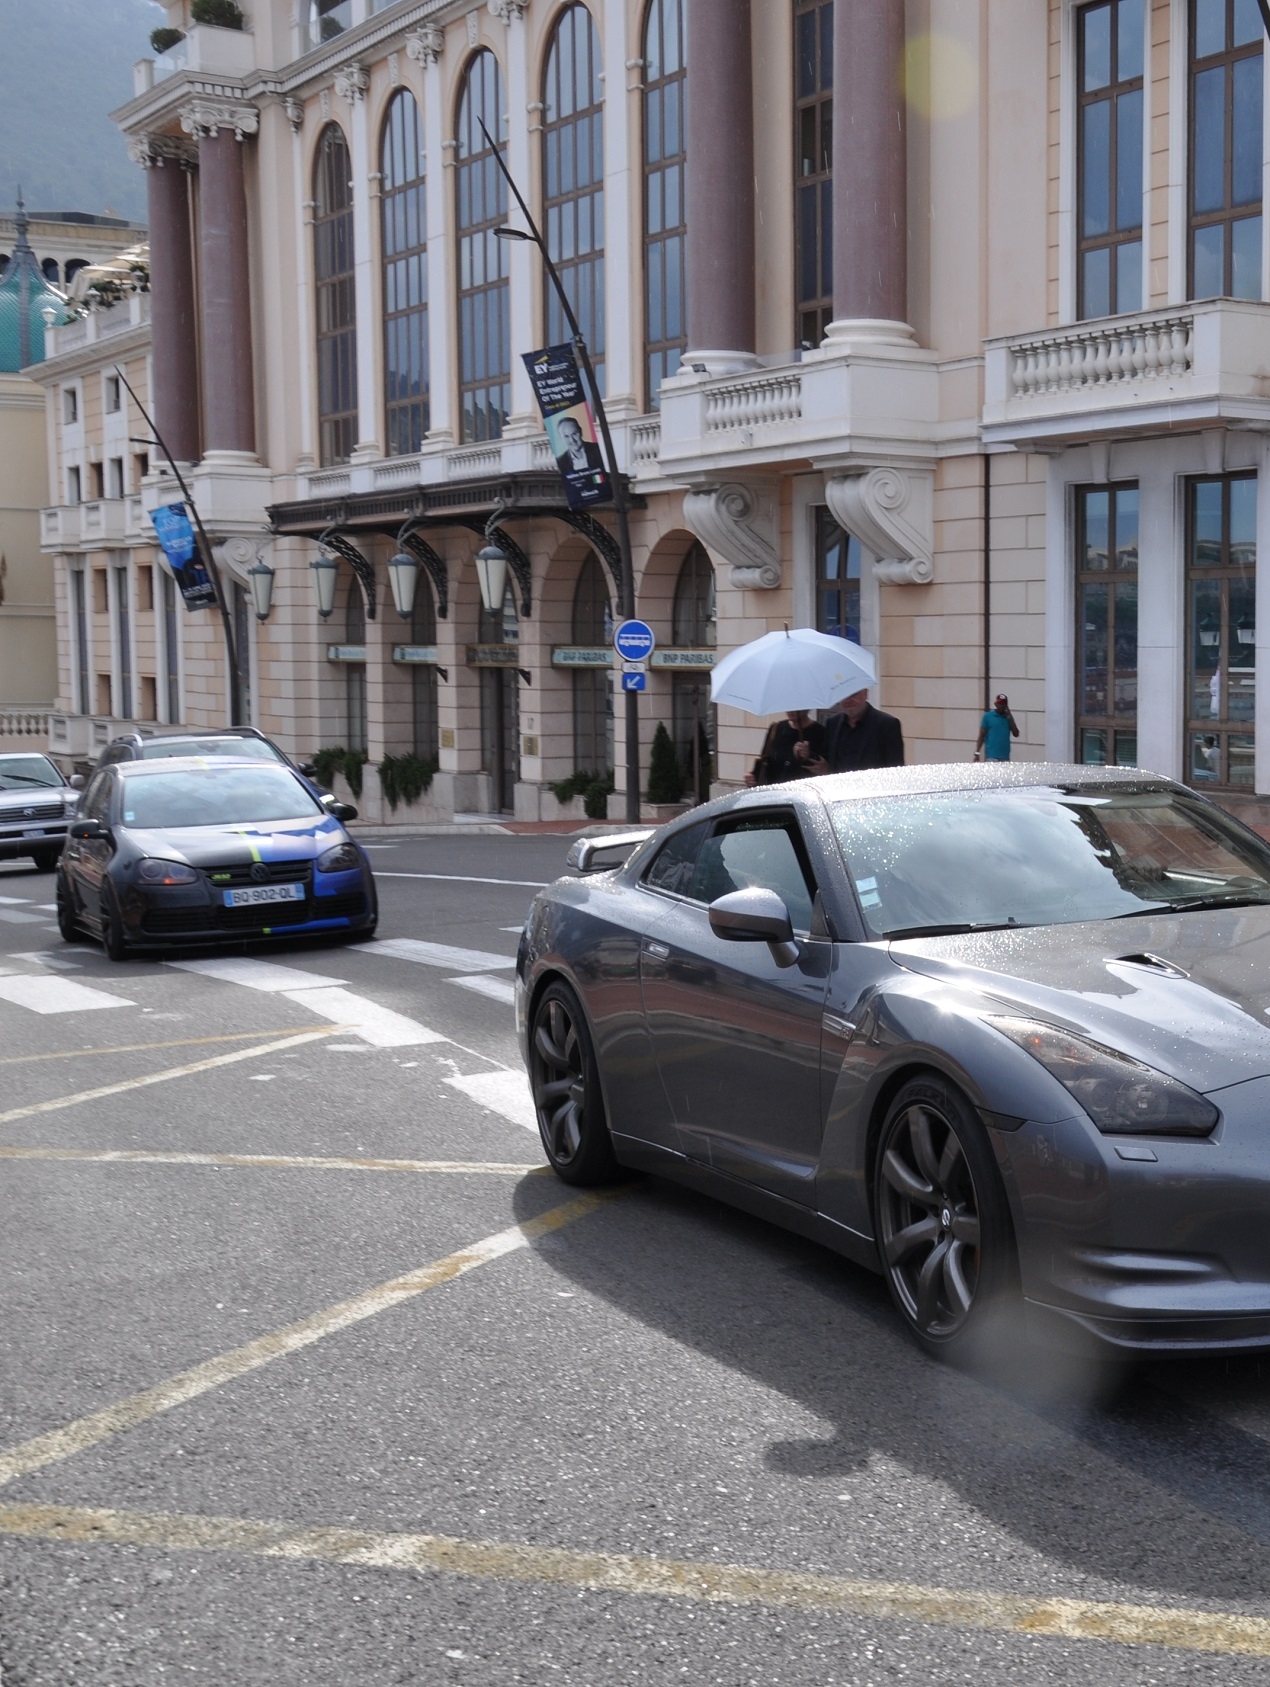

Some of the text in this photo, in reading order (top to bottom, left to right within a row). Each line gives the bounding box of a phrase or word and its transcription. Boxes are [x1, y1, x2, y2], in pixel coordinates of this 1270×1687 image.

[533, 362, 549, 375] EY
[577, 652, 607, 662] PARIBAS
[662, 653, 714, 664] BNP PARIBAS
